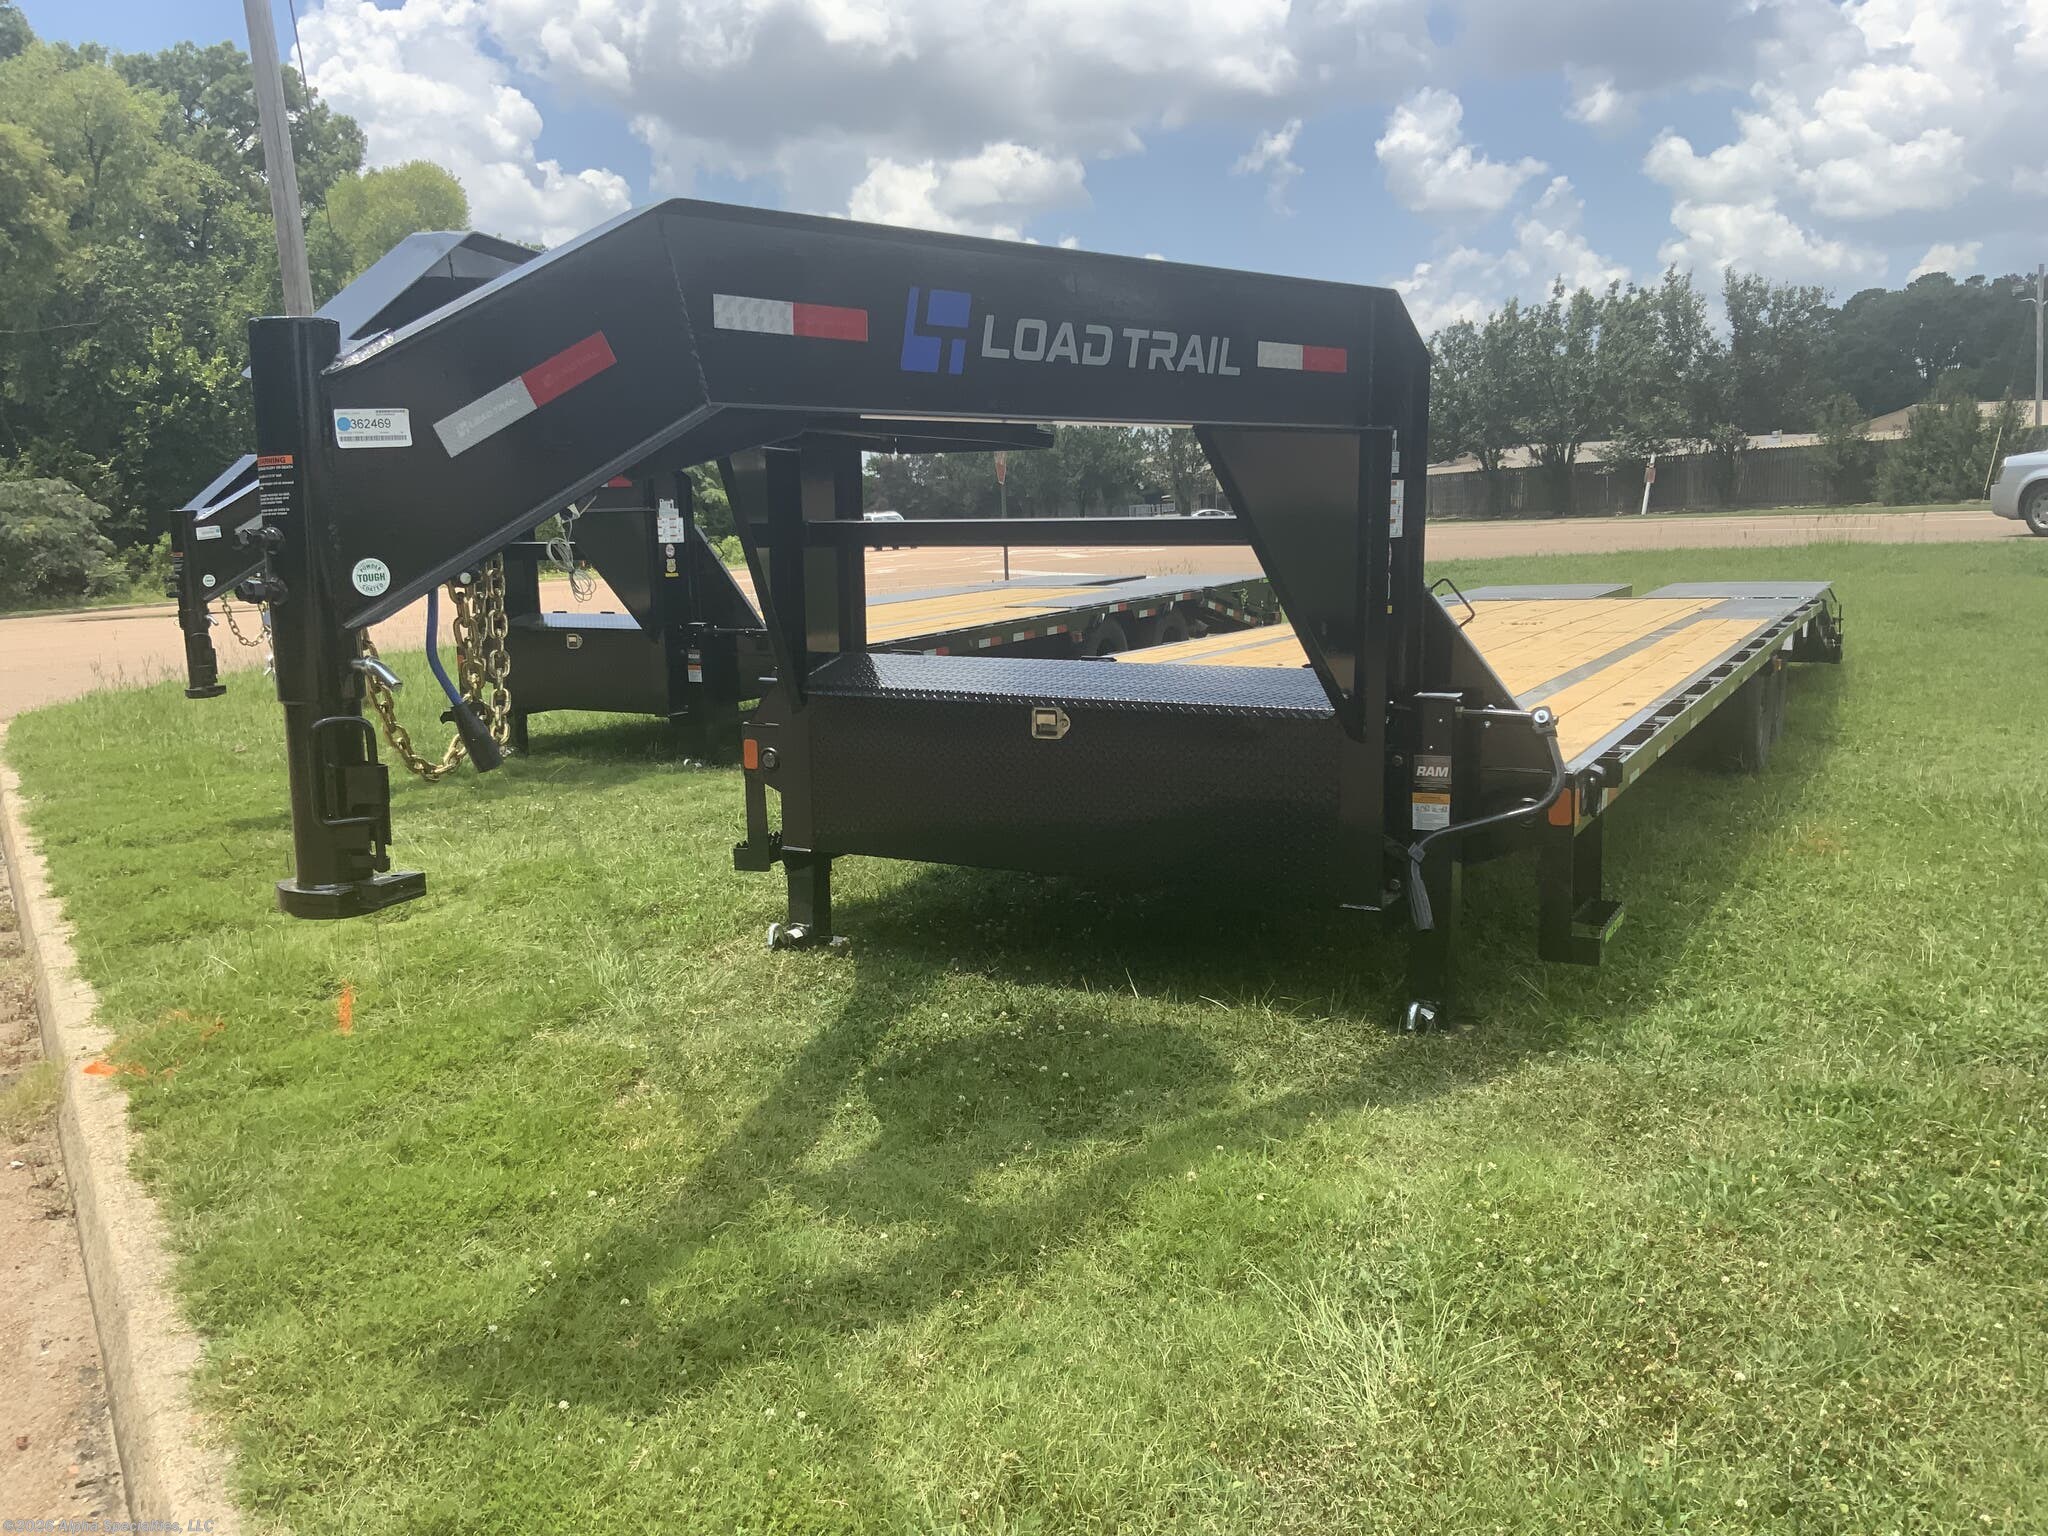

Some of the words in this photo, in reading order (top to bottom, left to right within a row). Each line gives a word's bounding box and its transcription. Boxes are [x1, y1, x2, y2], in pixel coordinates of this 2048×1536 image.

[981, 314, 1114, 366] LOAD
[1122, 327, 1242, 376] TRAIL
[350, 417, 392, 429] 362469
[357, 572, 386, 583] TOUGH
[1415, 765, 1449, 778] RAM
